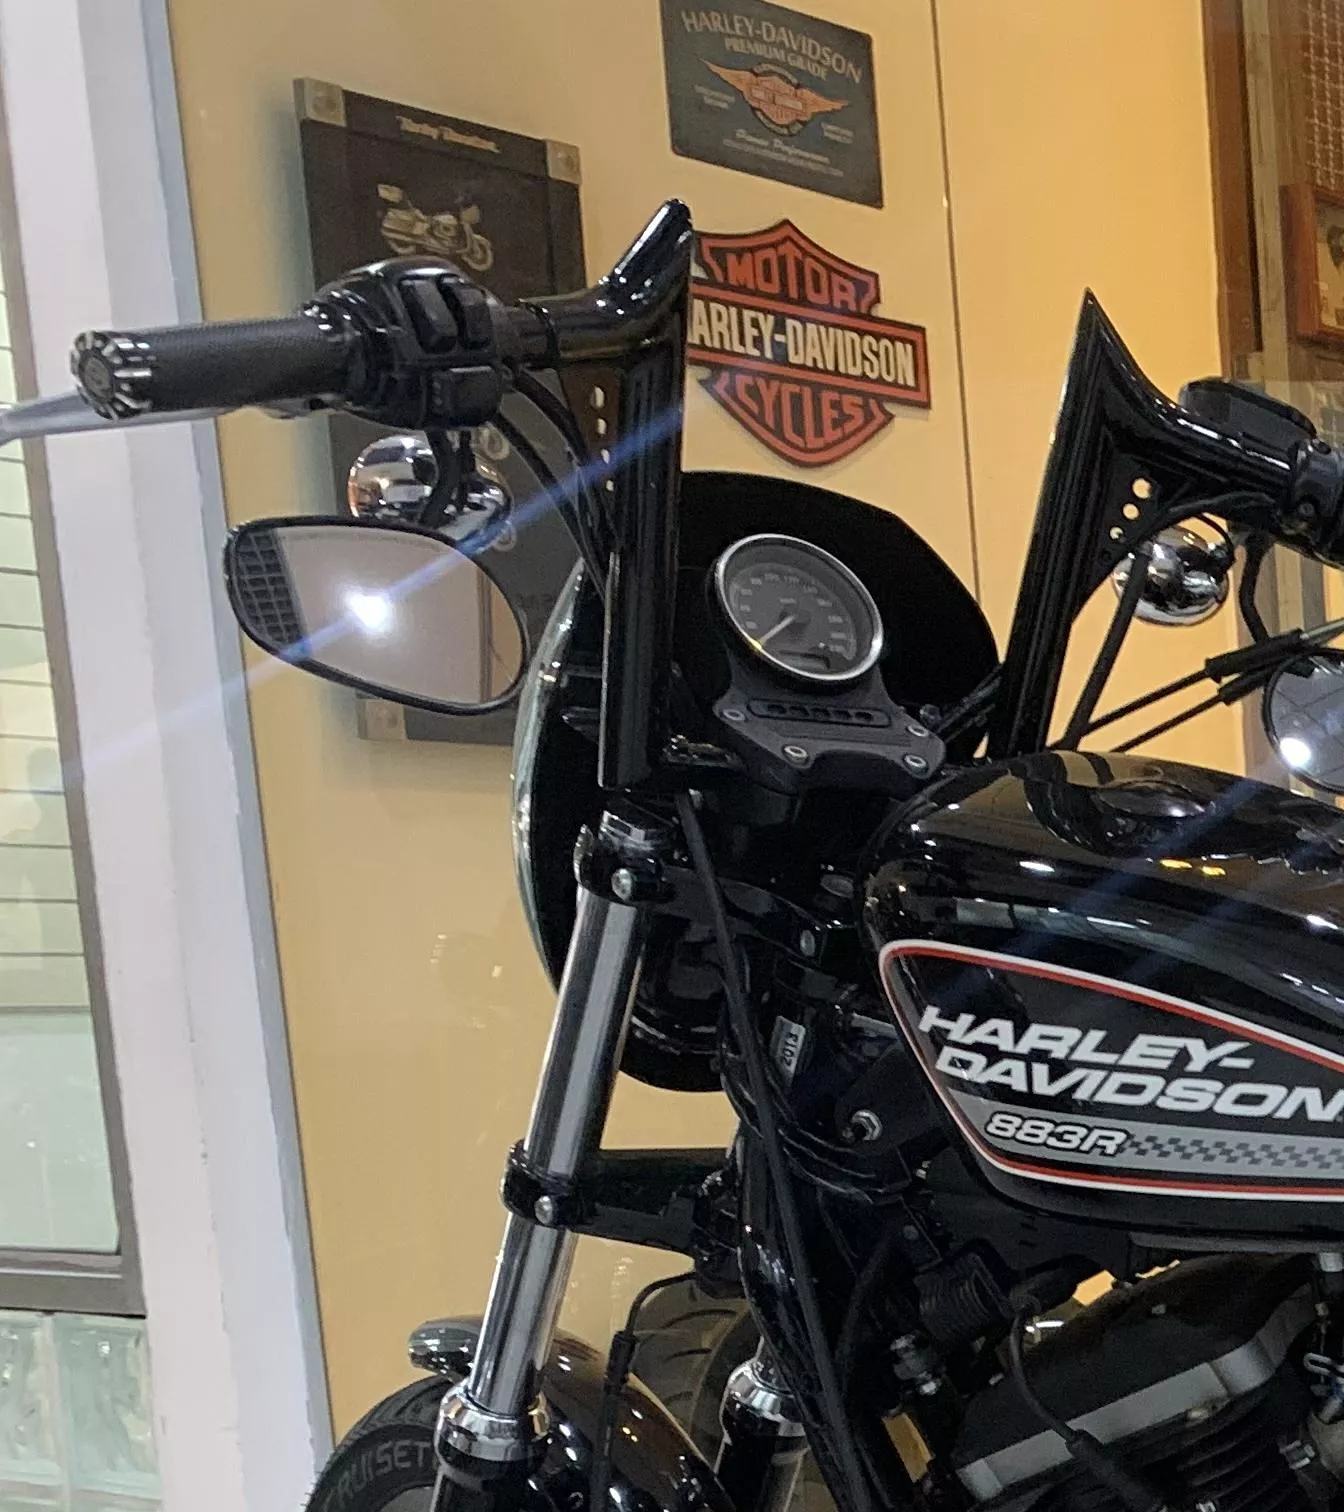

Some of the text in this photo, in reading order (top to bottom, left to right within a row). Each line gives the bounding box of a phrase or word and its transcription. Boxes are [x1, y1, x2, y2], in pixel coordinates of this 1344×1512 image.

[680, 11, 863, 84] HARLEY-DAVIDSON
[724, 37, 786, 62] PREMIUM
[726, 243, 858, 311] MOTOR
[689, 298, 916, 388] ARLEY-DAVIDSON
[735, 373, 865, 449] CYCLES
[918, 1005, 1256, 1072] HARLEY-
[984, 1110, 1132, 1158] 883R
